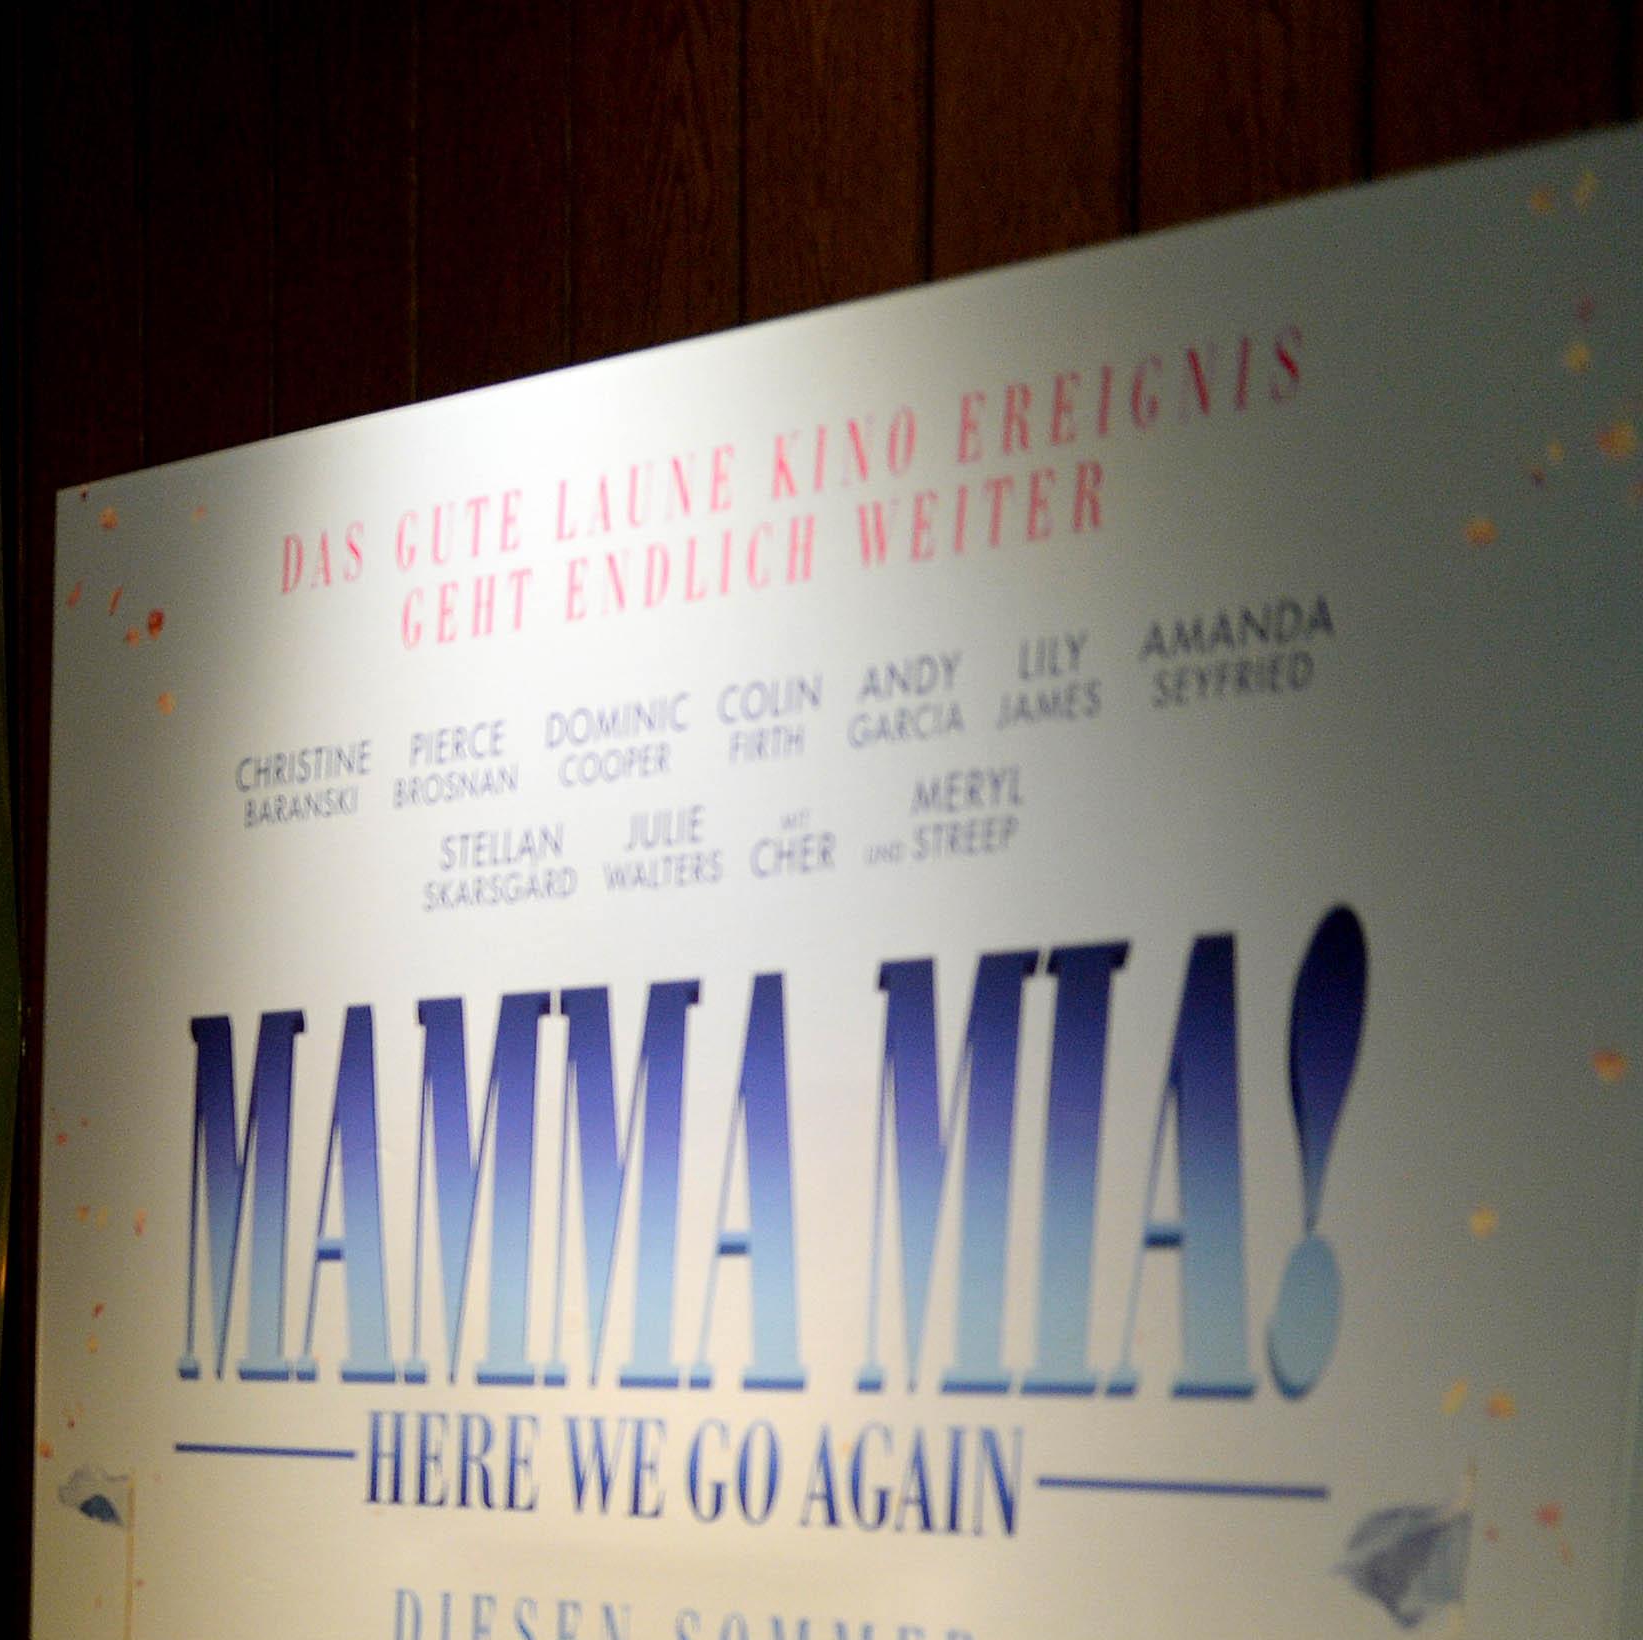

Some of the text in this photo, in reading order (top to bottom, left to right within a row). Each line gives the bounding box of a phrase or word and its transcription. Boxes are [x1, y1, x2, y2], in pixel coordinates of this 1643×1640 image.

[283, 324, 1303, 594] DAS GUTE LAUNE KINO EREIGNIS
[401, 460, 1103, 650] GEHT ENDLICH WEITER
[235, 594, 1335, 793] CHRISTINE PIERCE DOMINIC COLIN ANDY LILY AMANDA
[243, 651, 1313, 828] BARANSKI BROSNAN COOPER FIRTH GARCIA JAMES SEYFRIED
[440, 822, 564, 872] STELLAN
[627, 805, 706, 851] JULIE
[911, 763, 1023, 815] MERYL
[603, 849, 723, 892] WALTERS
[749, 831, 836, 880] CHER
[912, 815, 1018, 861] STREEP
[179, 903, 1369, 1400] MAMMA MIA!
[365, 1409, 1023, 1538] HERE WE GO AGAIN
